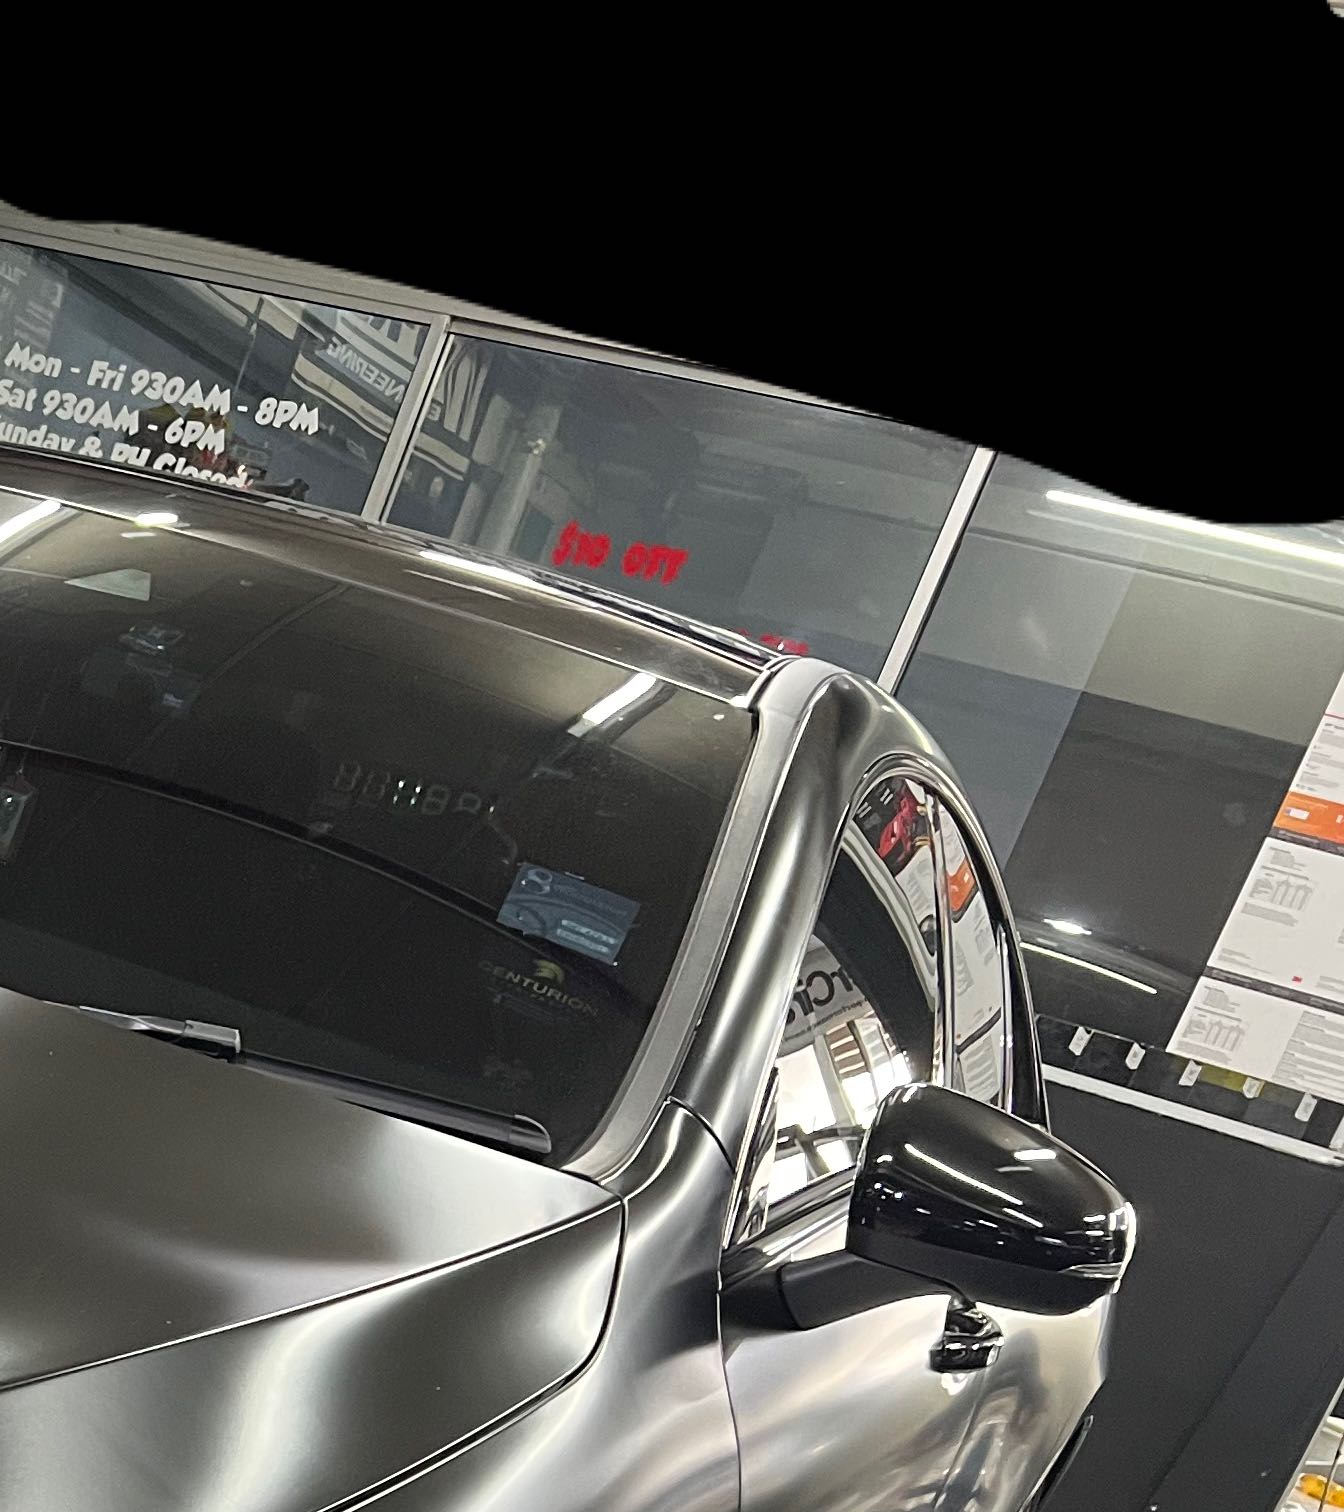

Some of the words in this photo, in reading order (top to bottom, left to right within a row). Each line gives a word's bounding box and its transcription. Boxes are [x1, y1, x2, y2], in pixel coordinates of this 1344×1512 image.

[3, 341, 63, 378] Mon
[87, 359, 128, 392] Fri
[130, 368, 231, 416] 930AM
[254, 397, 320, 436] 8PM
[42, 388, 140, 437] 930AM
[164, 416, 226, 456] 6PM
[78, 435, 104, 458] &
[477, 958, 600, 1018] CENTURION
